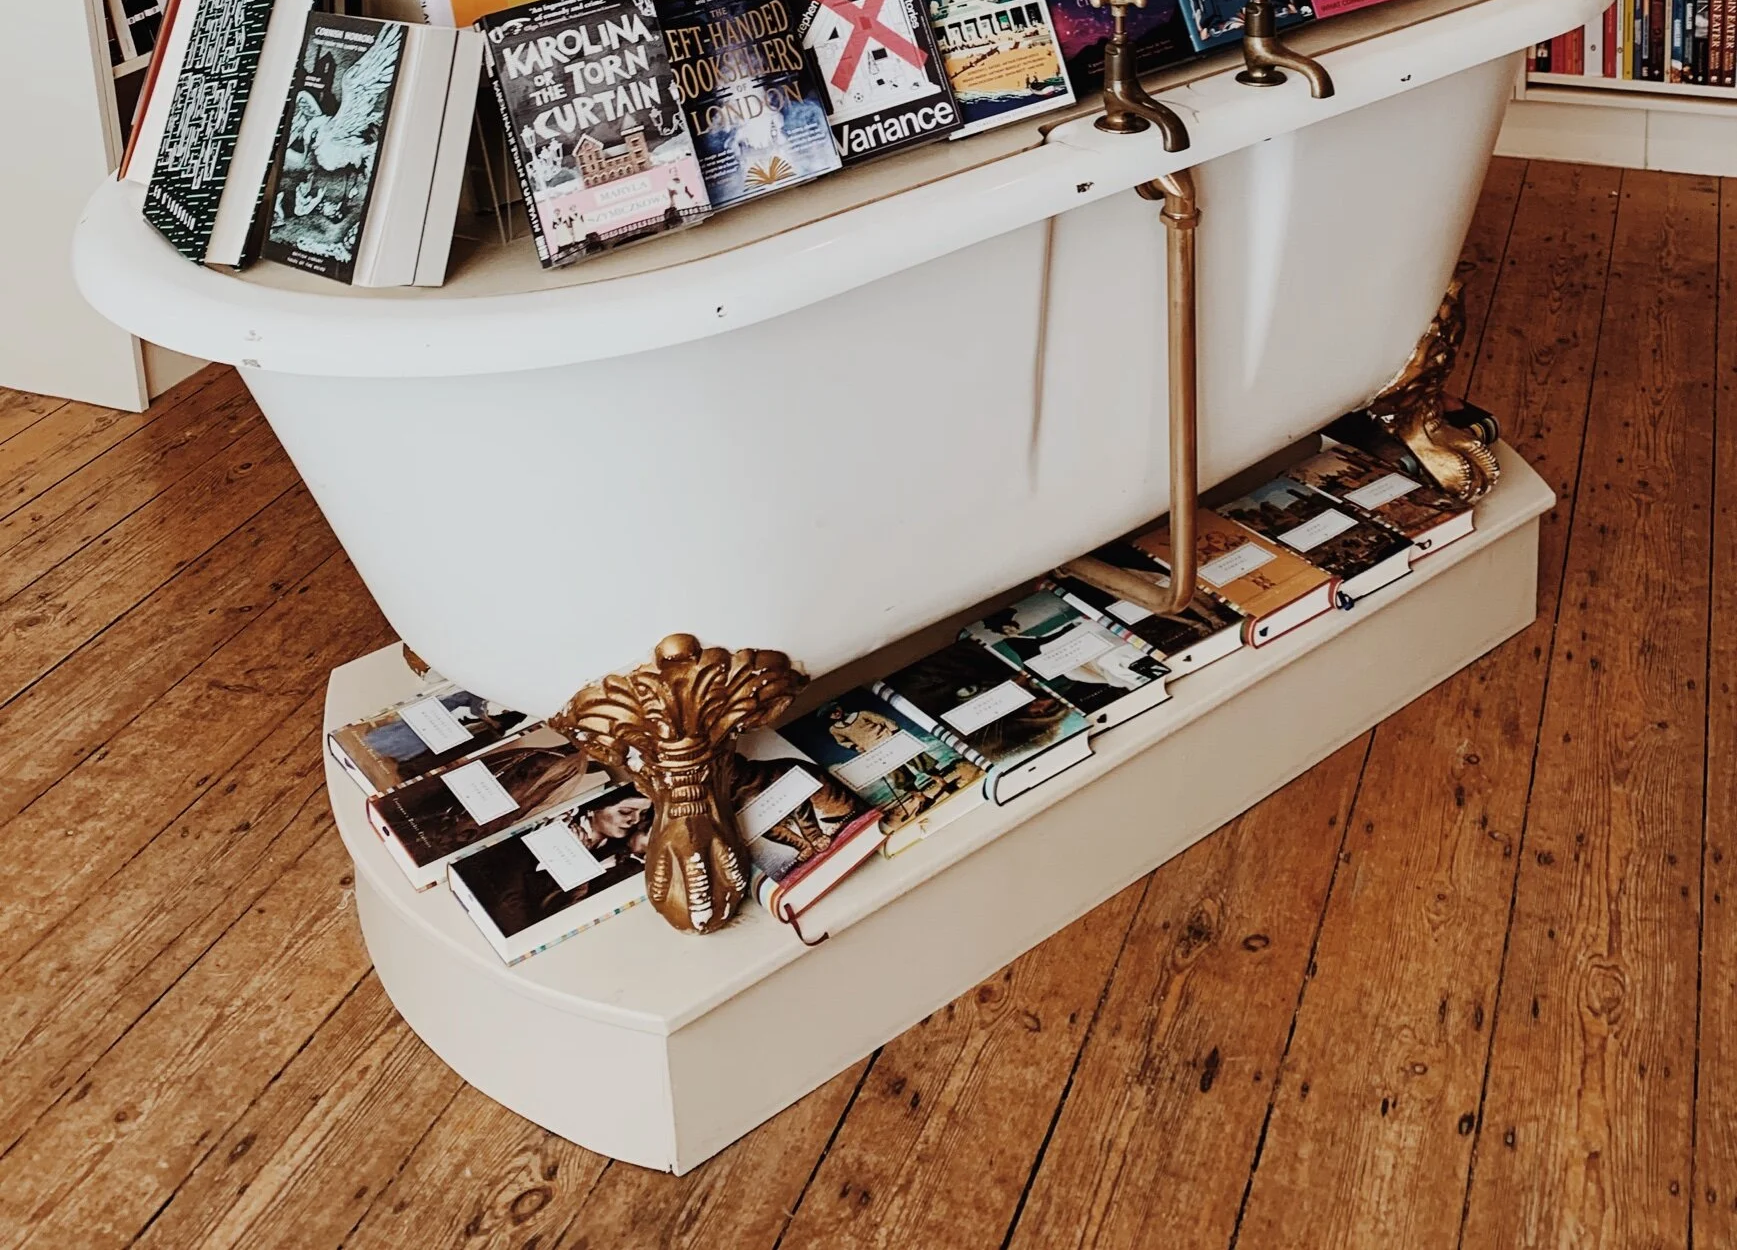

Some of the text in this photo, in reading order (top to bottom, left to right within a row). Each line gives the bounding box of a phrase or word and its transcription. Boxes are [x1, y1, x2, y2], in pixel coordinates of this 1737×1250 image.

[710, 7, 728, 18] THE
[1711, 14, 1721, 48] EATER
[502, 14, 660, 80] KAROLINA,
[671, 34, 803, 104] BOOKSELLERS
[529, 45, 650, 107] THE TORN
[533, 71, 556, 86] OR
[736, 83, 747, 93] OF
[533, 77, 662, 140] CURTAIN
[690, 80, 804, 136] LONDON
[837, 102, 954, 157] Variance
[520, 179, 542, 233] CURTAIN
[600, 181, 648, 203] MARYLA
